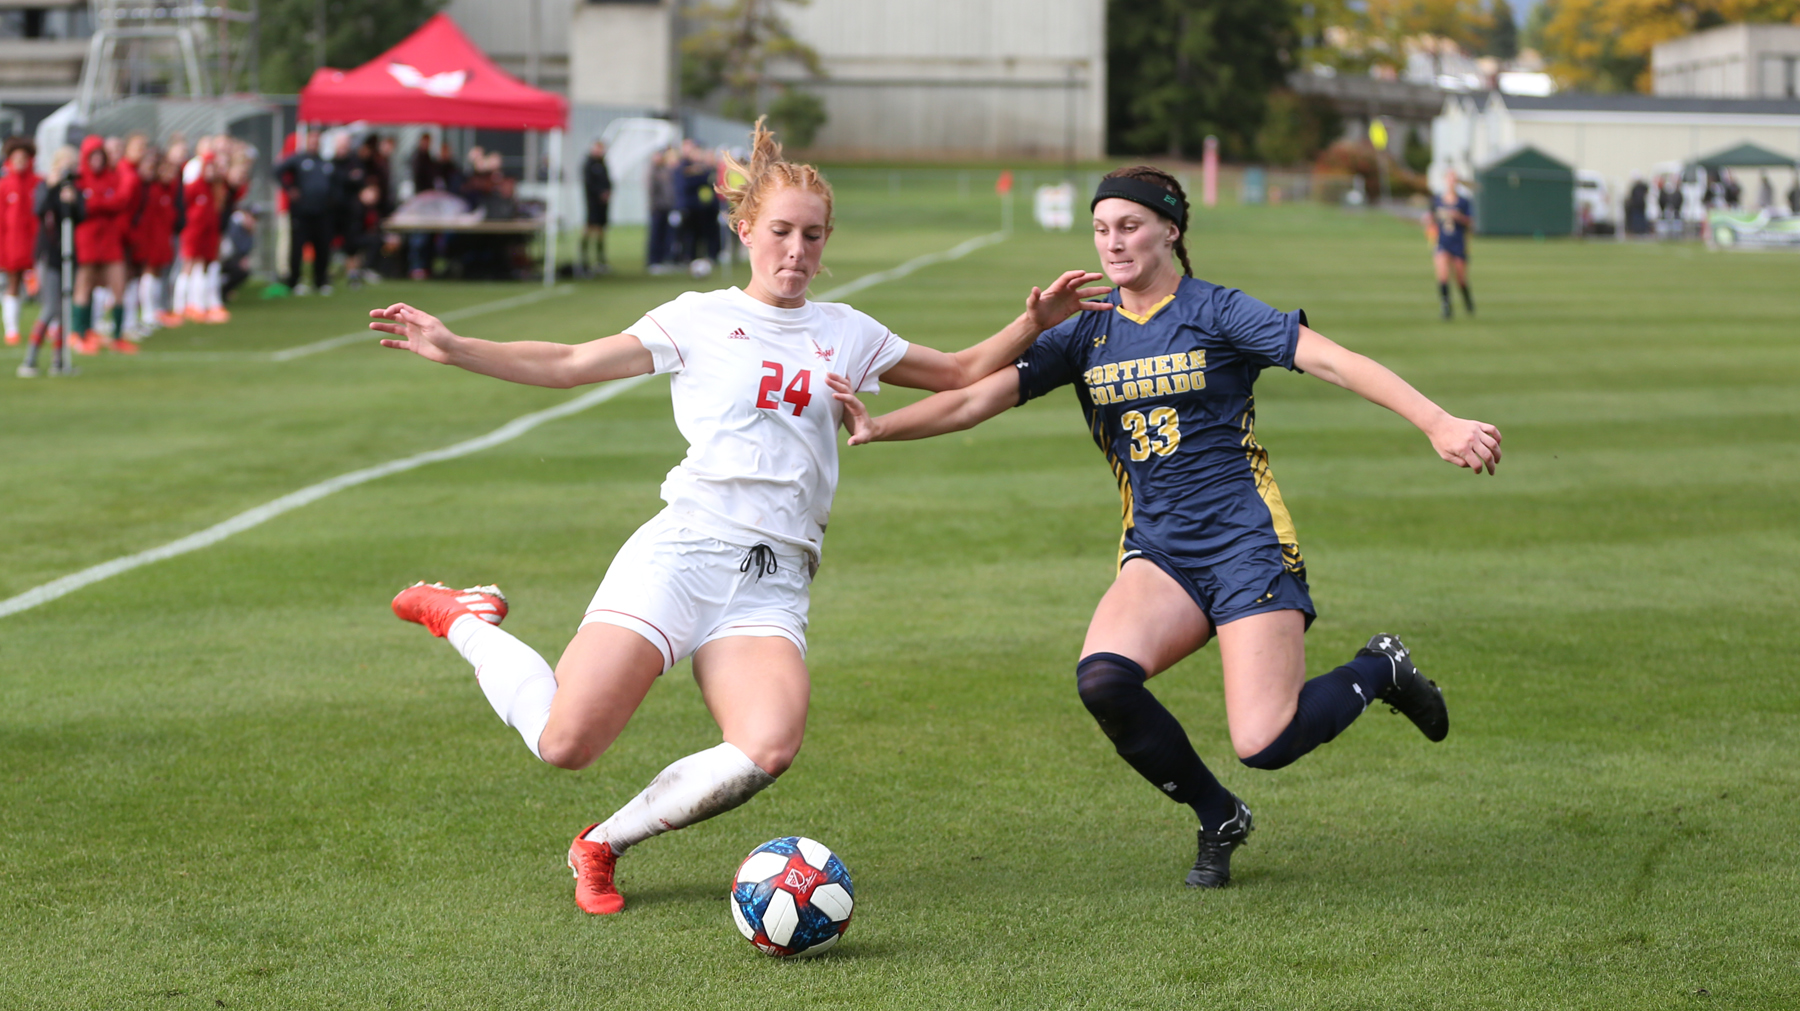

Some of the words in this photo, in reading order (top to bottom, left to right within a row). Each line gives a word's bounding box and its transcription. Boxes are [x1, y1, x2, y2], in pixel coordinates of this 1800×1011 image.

[756, 360, 812, 417] 24
[1089, 371, 1206, 405] COLORADO
[1121, 406, 1181, 462] 33
